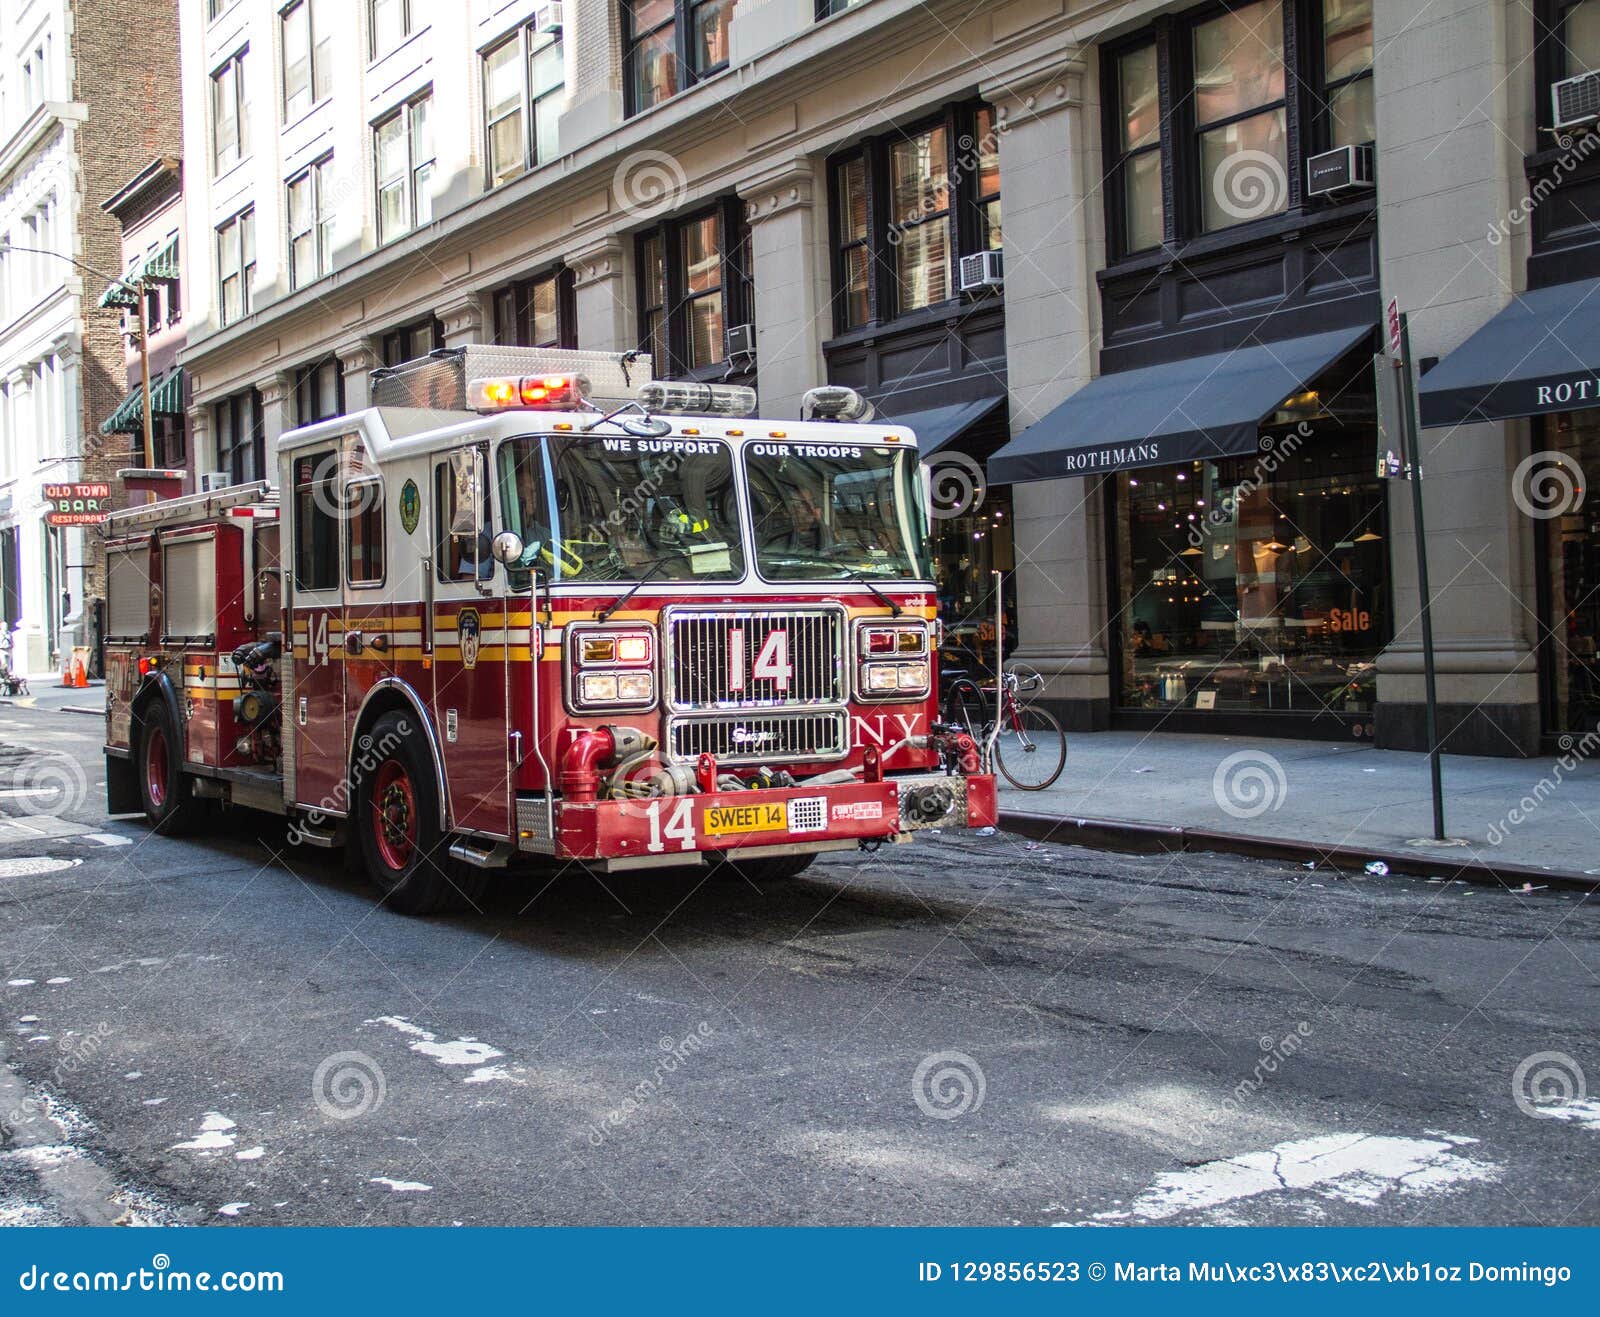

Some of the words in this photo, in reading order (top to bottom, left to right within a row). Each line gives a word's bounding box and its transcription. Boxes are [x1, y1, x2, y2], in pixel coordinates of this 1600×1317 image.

[603, 439, 632, 451] WE
[637, 440, 720, 454] SUPPORT
[753, 443, 790, 456] OUR
[797, 445, 862, 458] TROOPS
[1066, 443, 1159, 470] ROTHMANS
[46, 485, 71, 497] OLD
[75, 485, 108, 497] TOWN
[59, 499, 99, 513] BAR
[51, 514, 107, 524] RESTAURANT
[1330, 607, 1369, 632] Sale
[307, 612, 329, 666] 14
[729, 628, 793, 692] 14
[645, 798, 697, 852] 14
[709, 807, 761, 829] SWEET
[765, 805, 782, 825] 14
